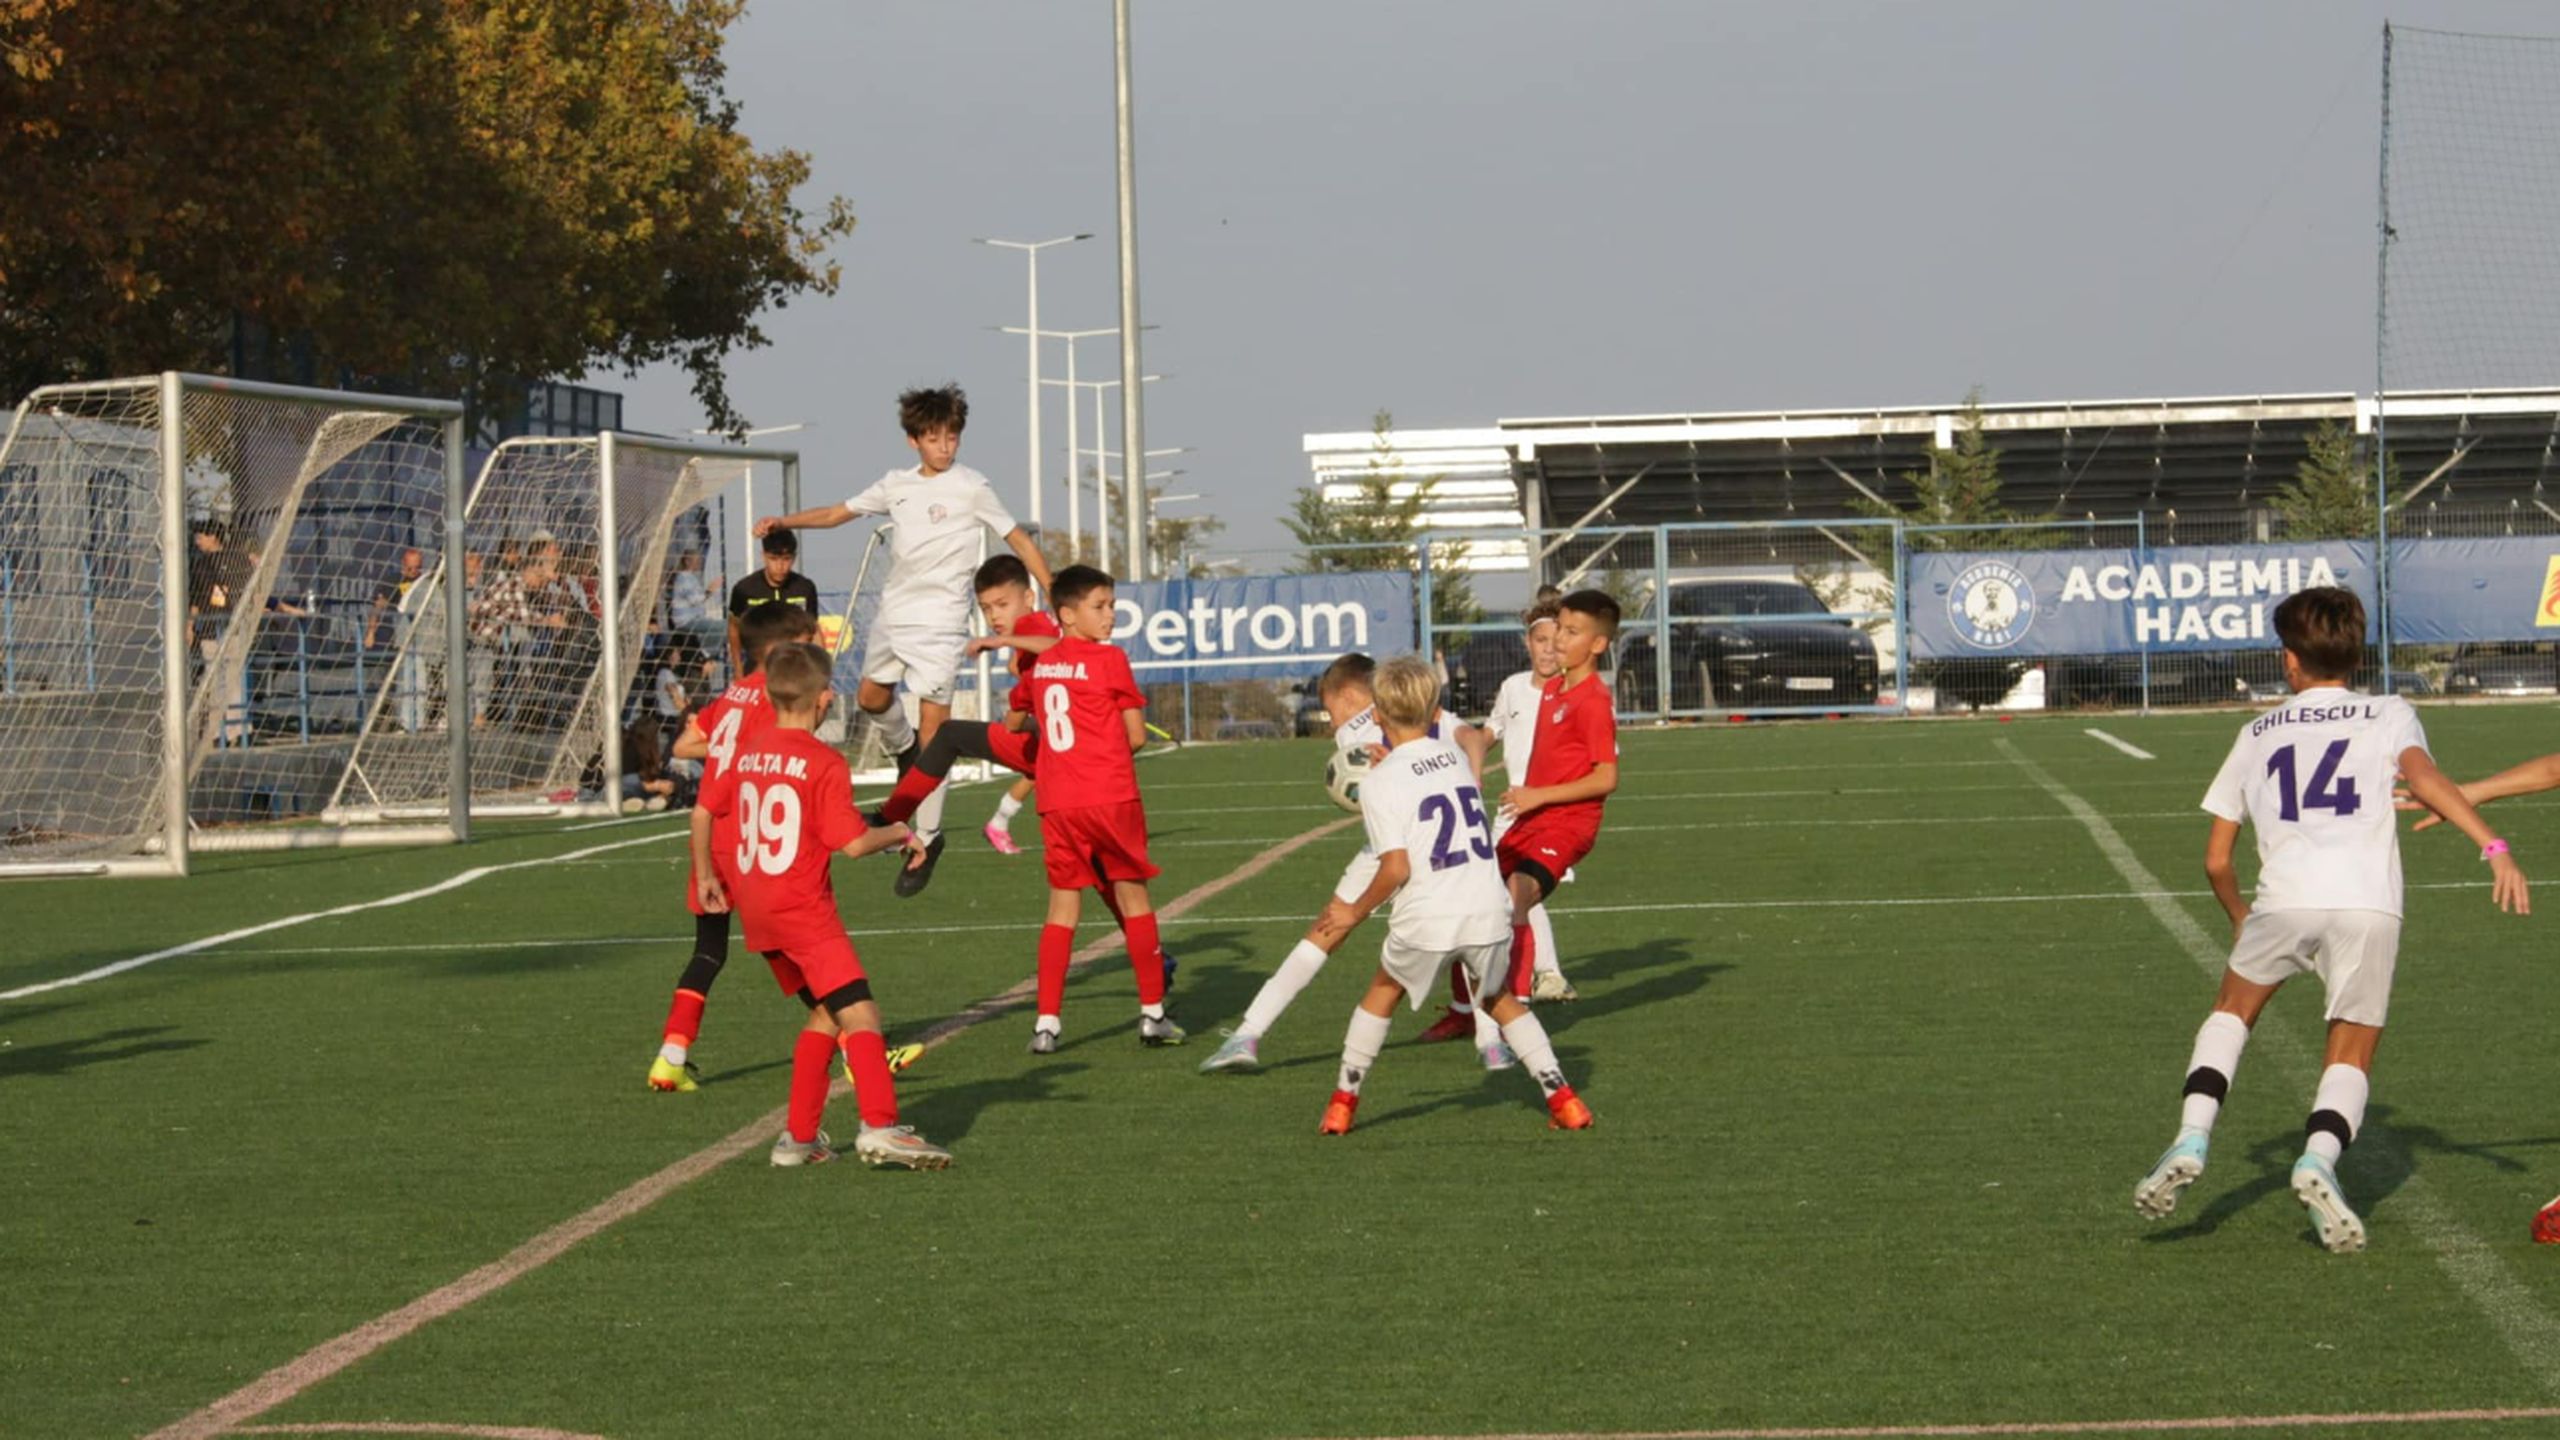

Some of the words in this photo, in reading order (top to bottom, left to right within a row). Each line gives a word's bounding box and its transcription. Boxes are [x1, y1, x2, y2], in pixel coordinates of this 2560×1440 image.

[2061, 557, 2337, 602] ACADEMIA
[1099, 597, 1368, 655] Petrom
[2135, 602, 2264, 643] HAGI
[708, 707, 742, 780] 4
[1044, 684, 1075, 752] 8
[2252, 705, 2356, 737] GHILESCU
[784, 755, 808, 781] M.
[2267, 738, 2361, 822] 14
[736, 781, 801, 875] 99
[1418, 785, 1494, 871] 25
